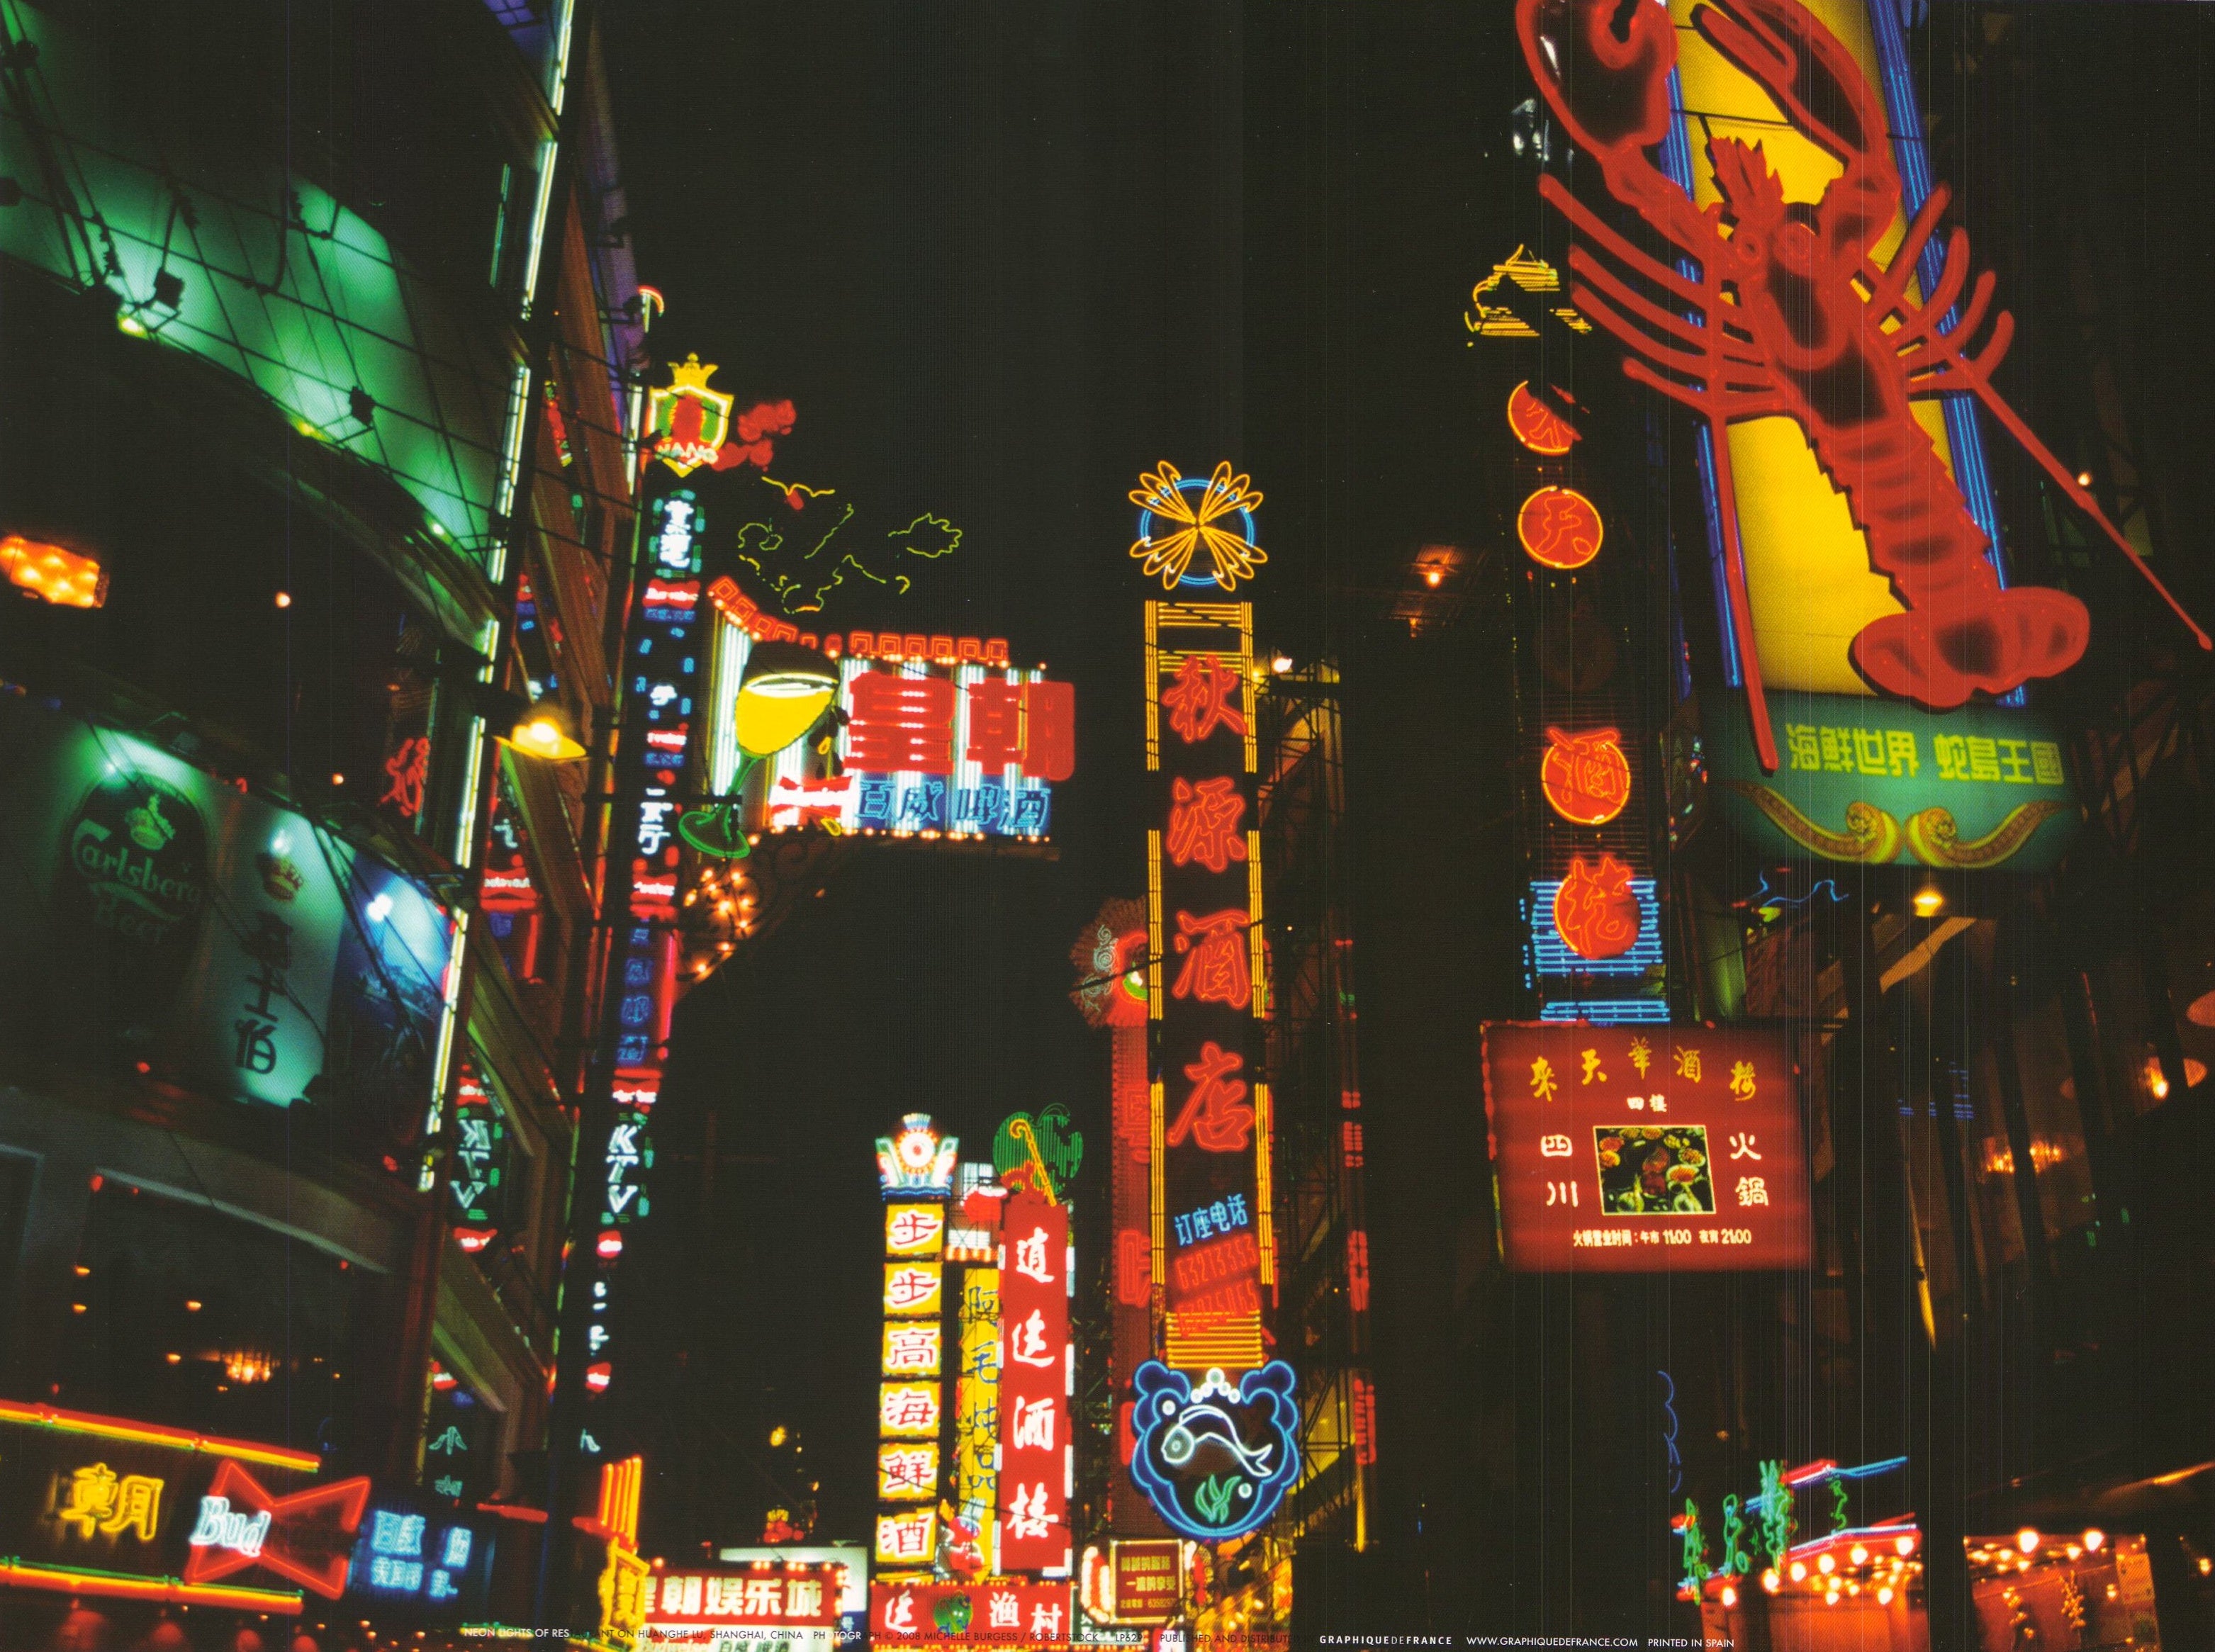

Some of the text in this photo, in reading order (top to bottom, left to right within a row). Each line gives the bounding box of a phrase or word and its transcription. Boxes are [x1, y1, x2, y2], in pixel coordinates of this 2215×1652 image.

[856, 779, 1052, 831] 百威啤酒
[72, 819, 201, 904] Carlsberg
[606, 1123, 639, 1213] KTV
[1174, 1193, 1248, 1246] 订座电话
[189, 1495, 271, 1558] Bud
